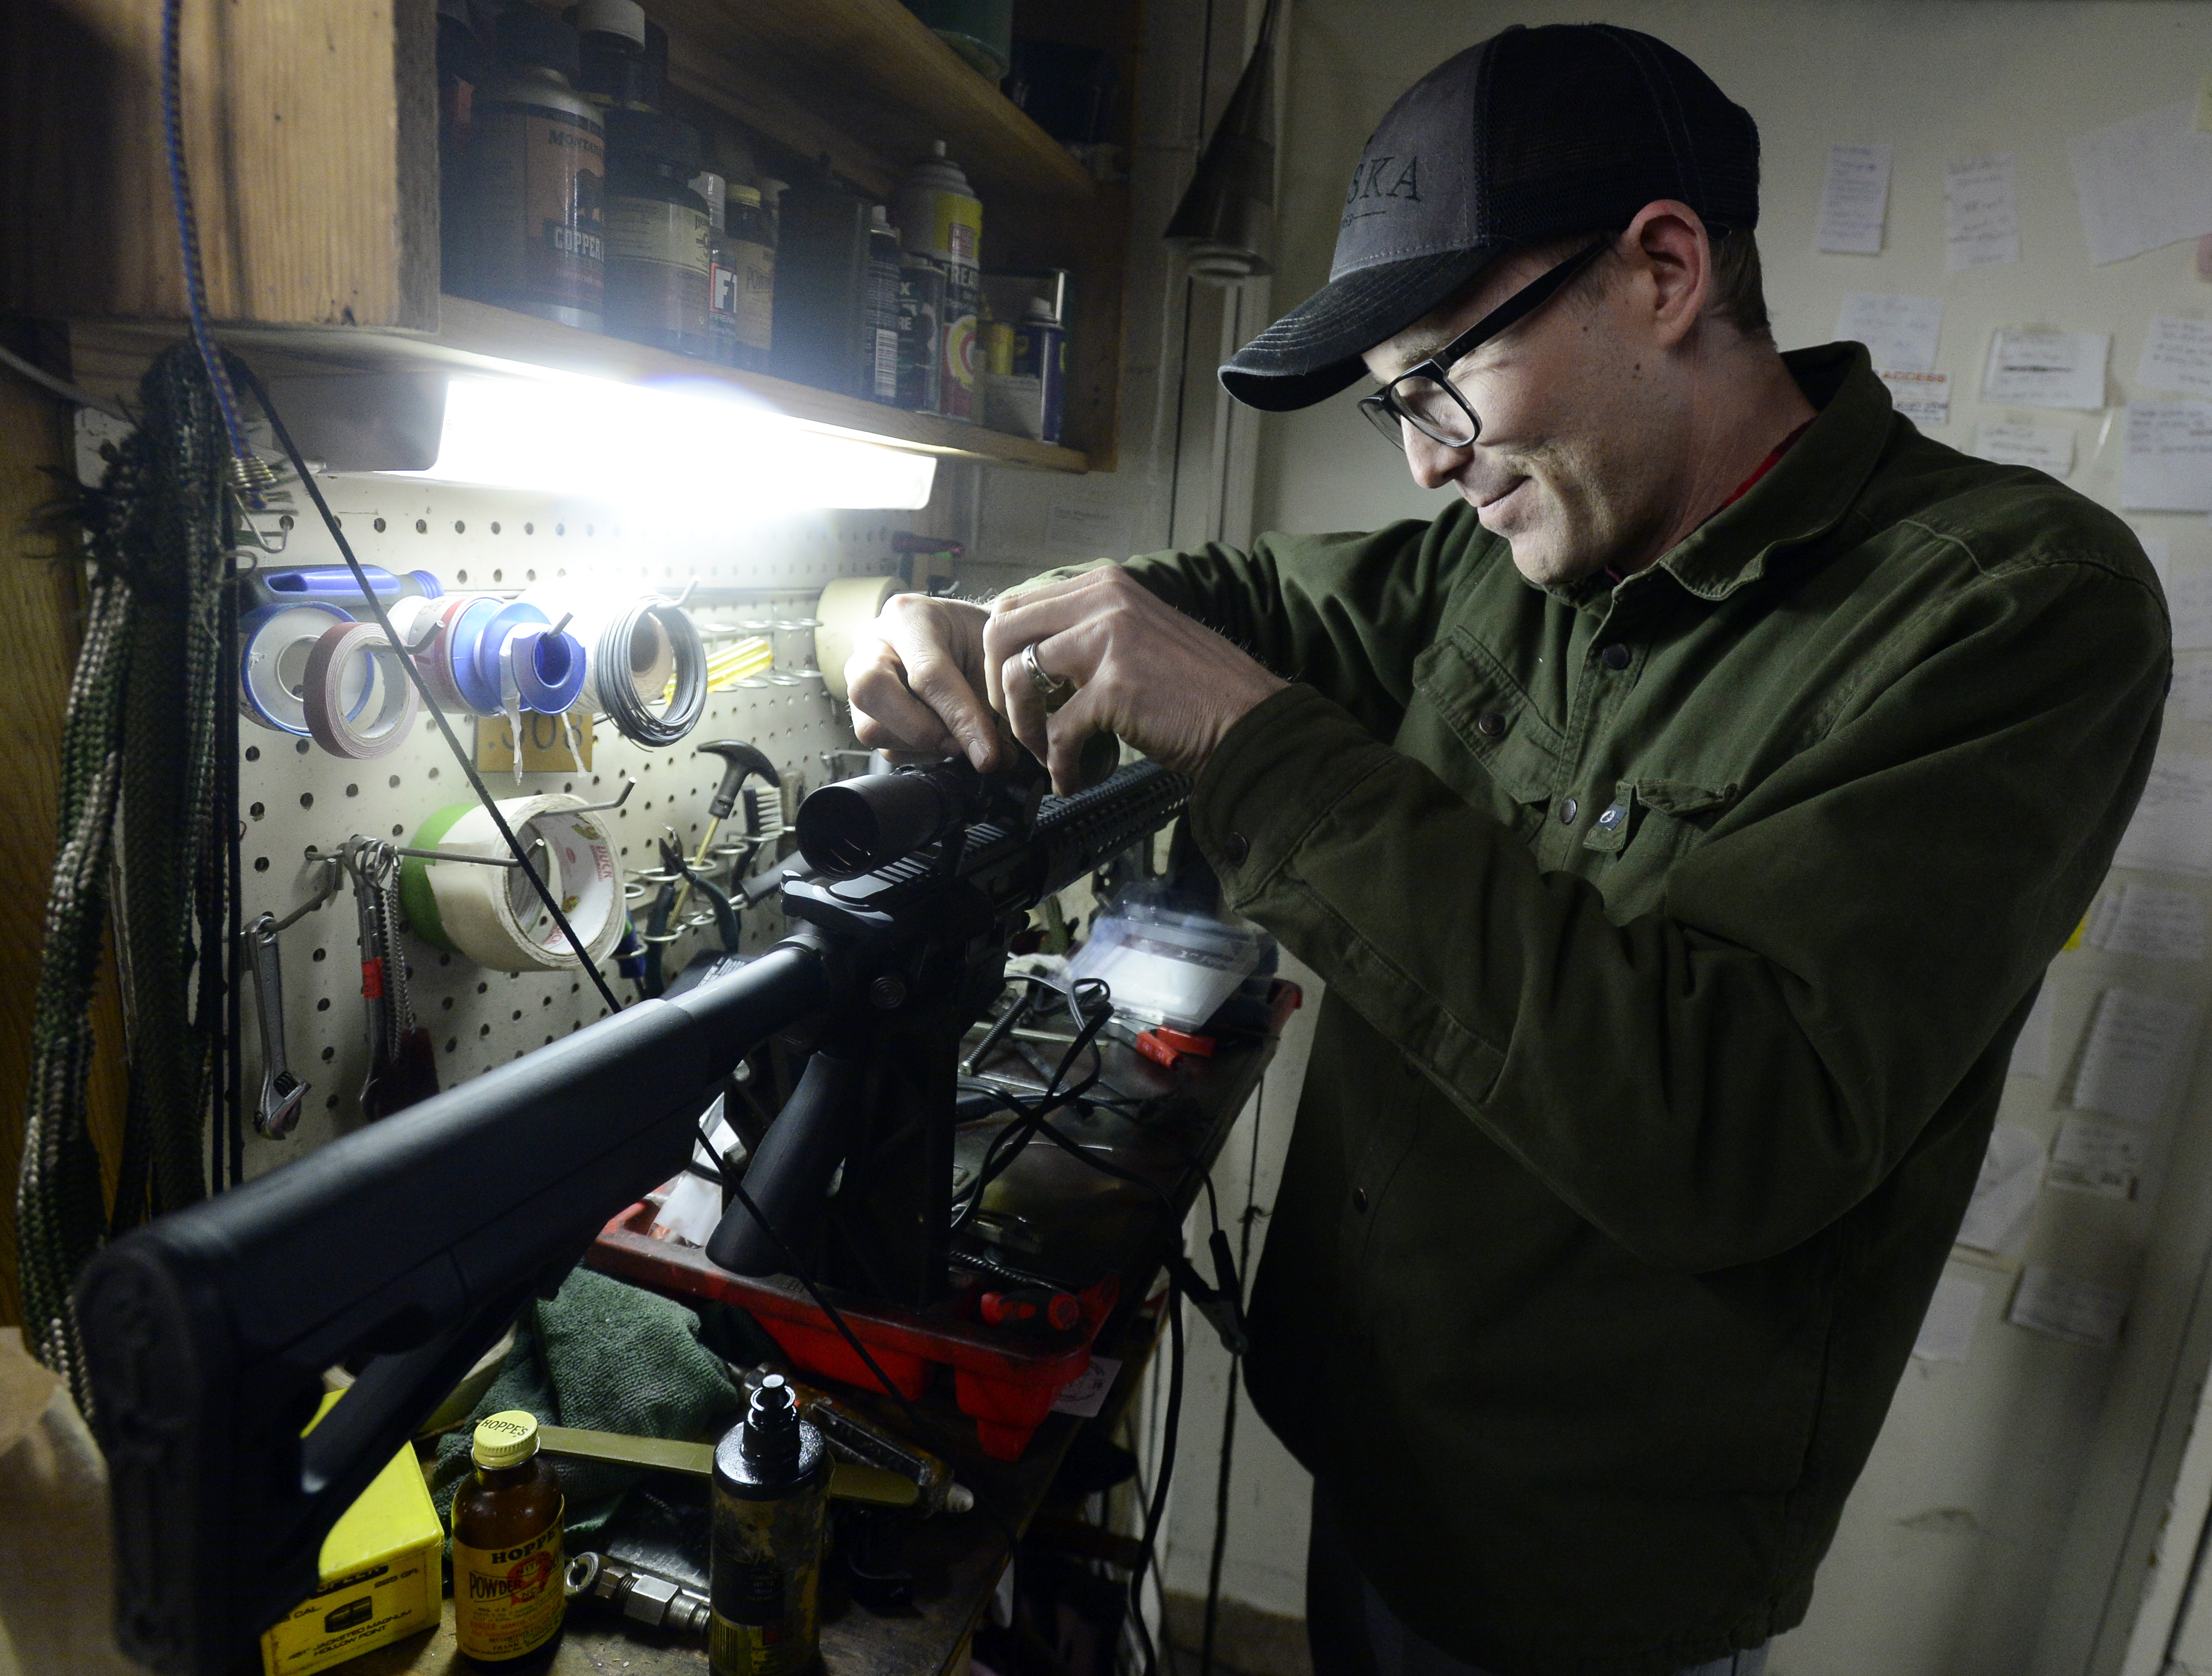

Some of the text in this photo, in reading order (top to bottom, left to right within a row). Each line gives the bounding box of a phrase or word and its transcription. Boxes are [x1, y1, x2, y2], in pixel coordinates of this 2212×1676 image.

[480, 1419, 528, 1436] HOPPE'S
[469, 1571, 522, 1599] POWDER
[367, 1609, 412, 1630] MAGNUM
[358, 1625, 387, 1640] POINT
